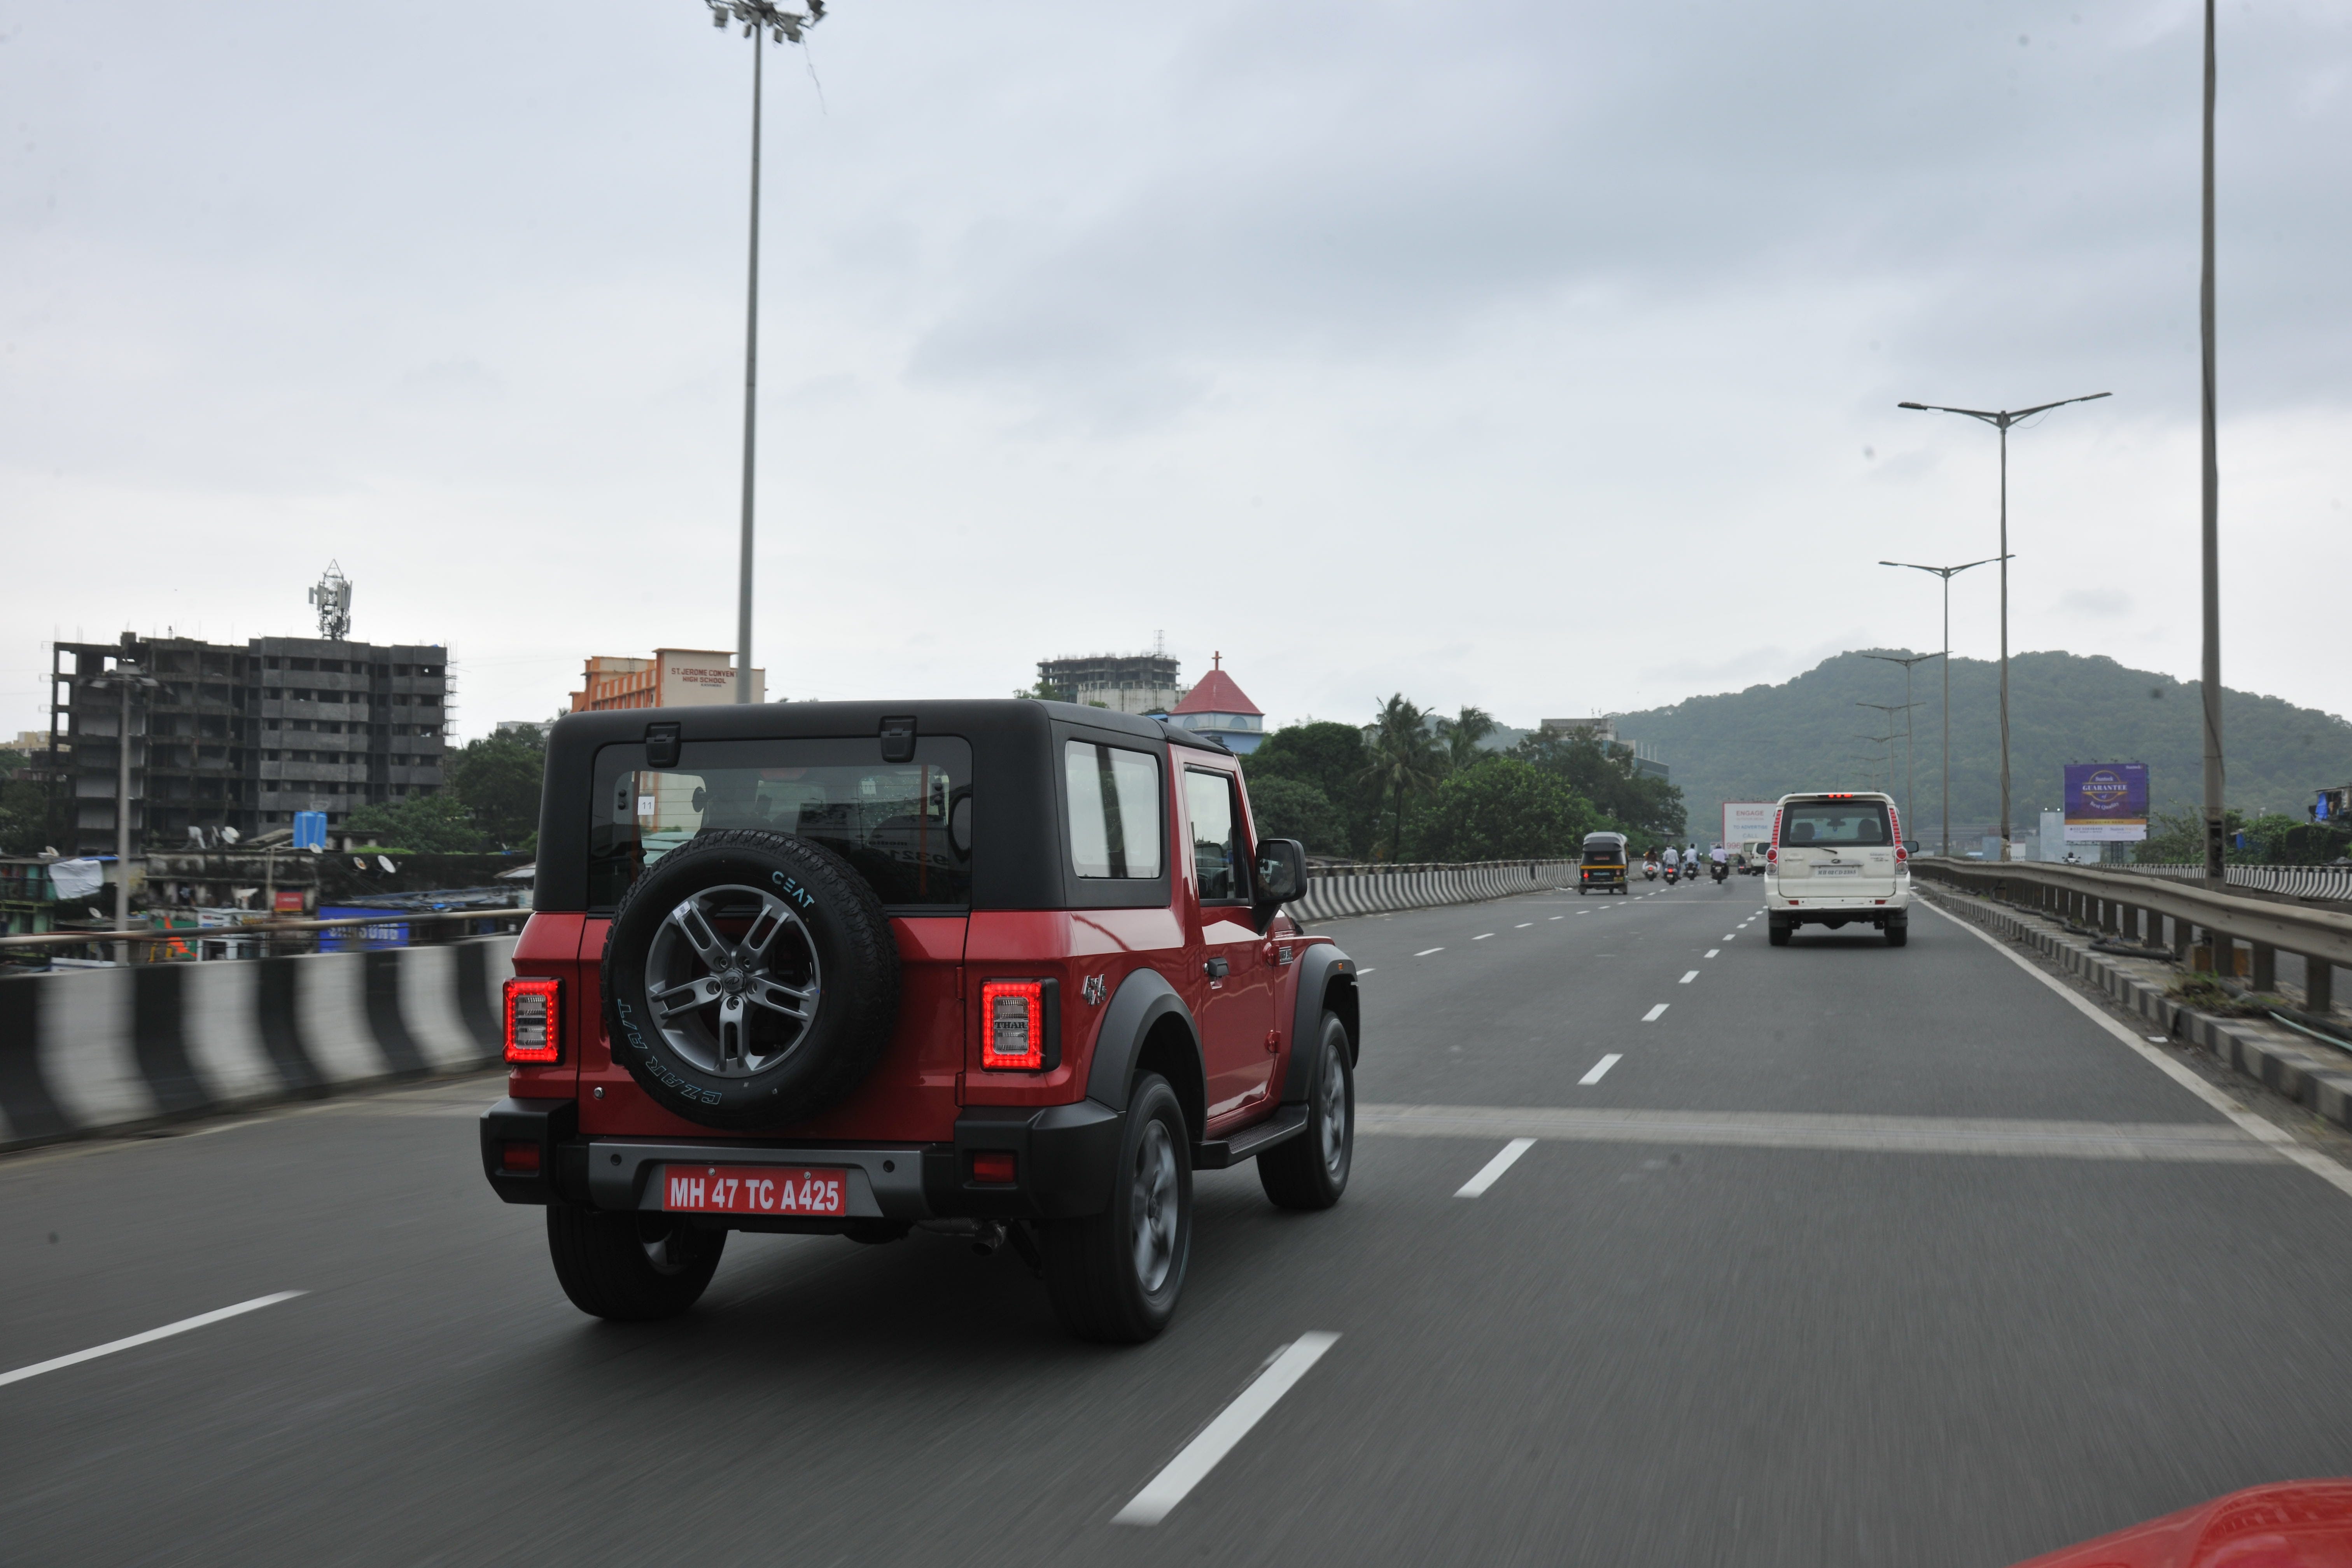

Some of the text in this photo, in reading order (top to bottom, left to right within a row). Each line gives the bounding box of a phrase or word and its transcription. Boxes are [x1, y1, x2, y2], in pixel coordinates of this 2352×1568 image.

[2101, 802, 2119, 810] Quality
[772, 871, 815, 908] CEAT
[646, 1055, 722, 1105] CZAR
[670, 1178, 839, 1211] MH 47 TC A425
